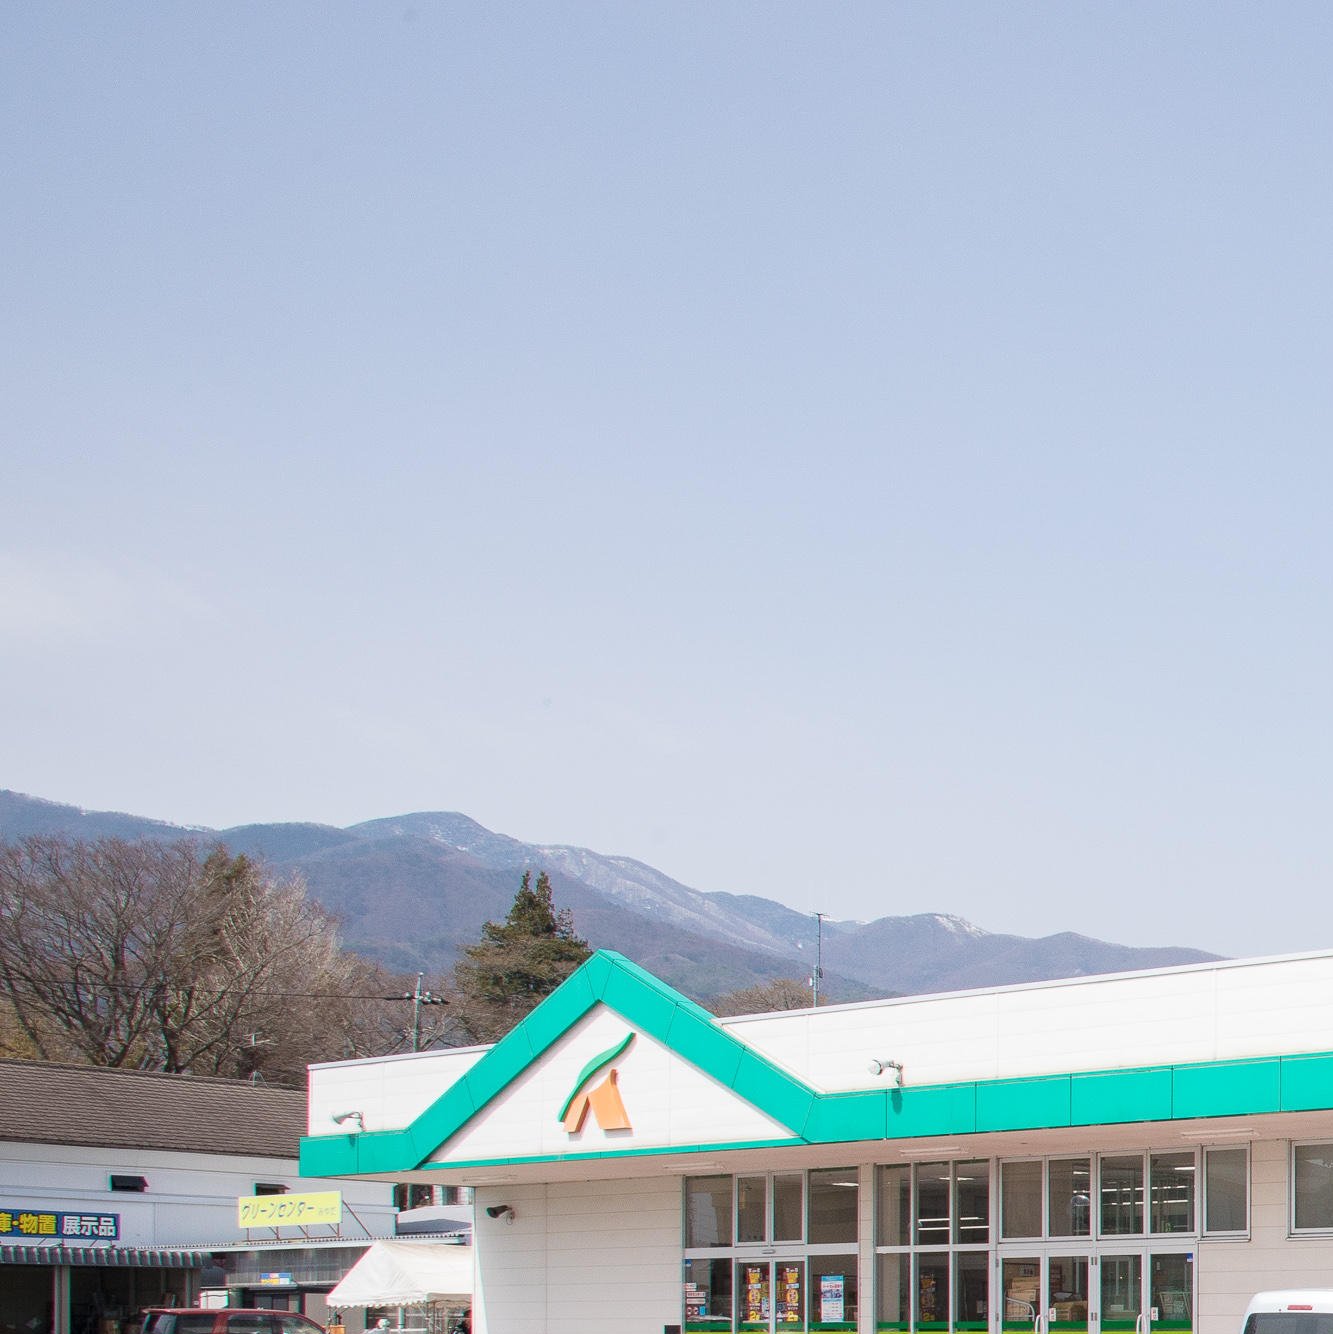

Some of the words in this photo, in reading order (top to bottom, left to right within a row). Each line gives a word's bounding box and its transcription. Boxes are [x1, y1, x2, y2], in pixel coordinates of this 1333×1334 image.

[243, 1202, 315, 1219] グリーンセンター
[62, 1215, 116, 1236] 展示品
